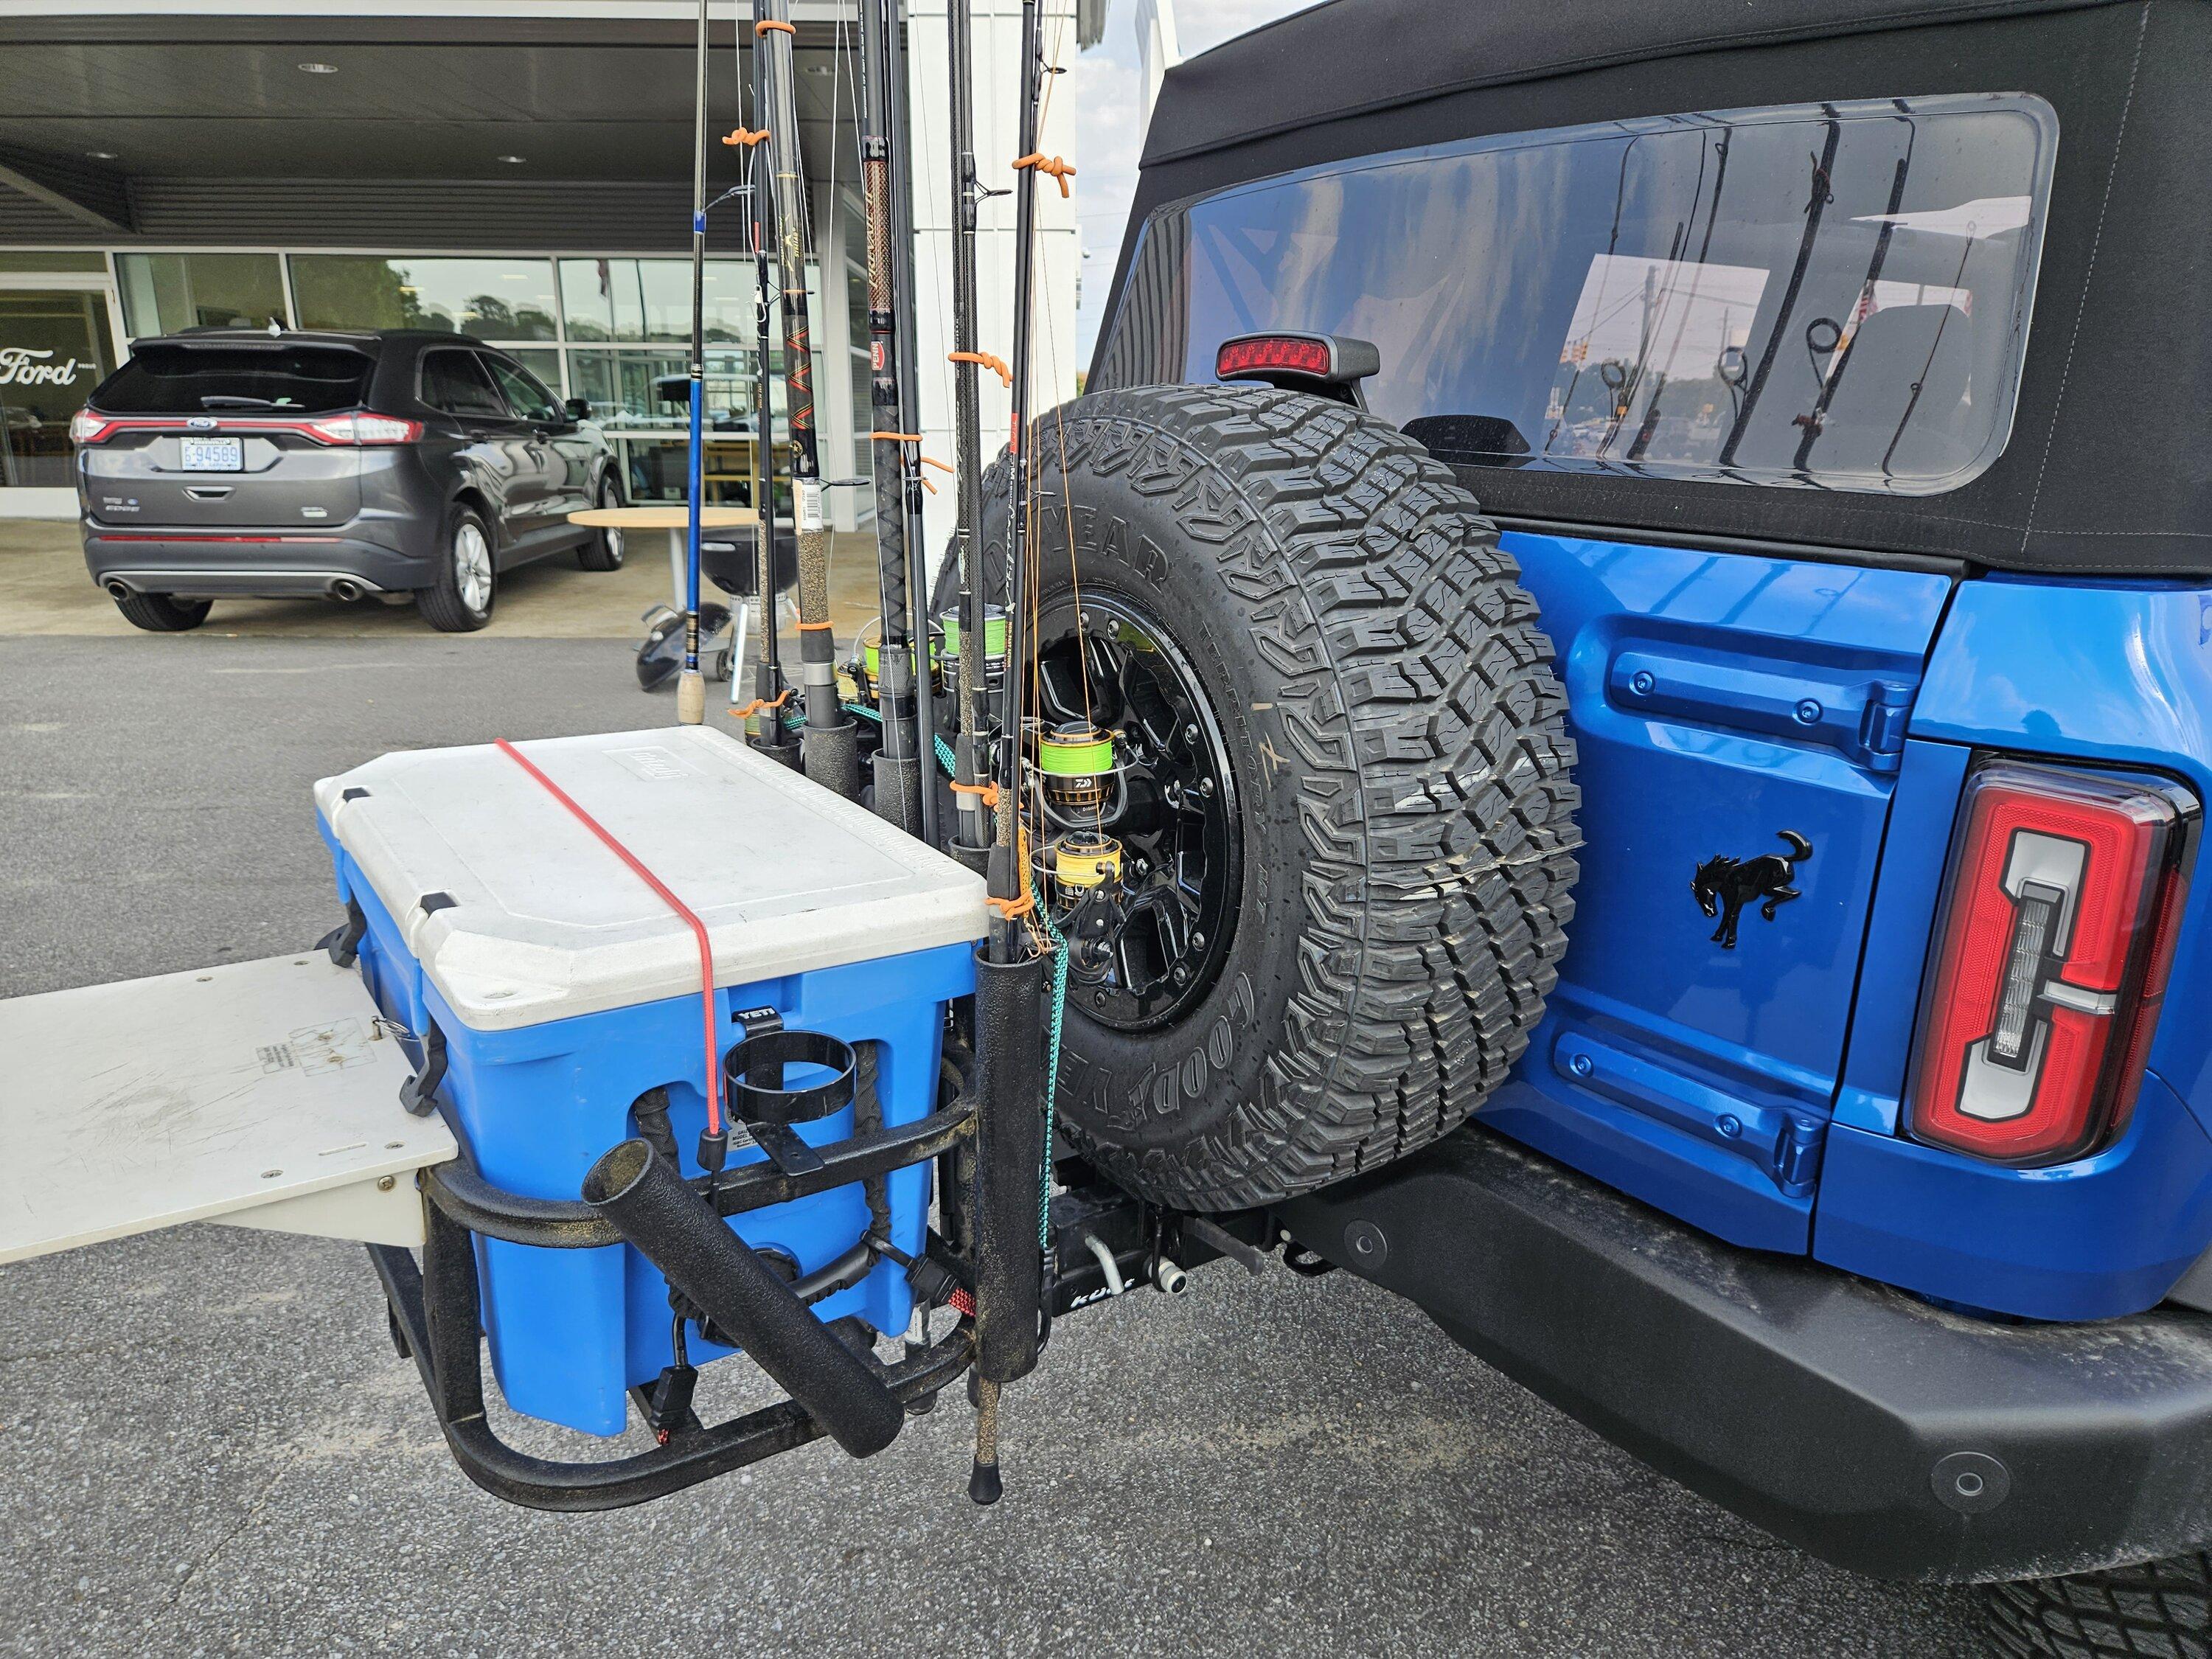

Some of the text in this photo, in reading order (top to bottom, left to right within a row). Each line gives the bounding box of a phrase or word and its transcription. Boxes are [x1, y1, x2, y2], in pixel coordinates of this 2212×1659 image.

[866, 212, 877, 288] PREVAIL
[0, 347, 77, 385] Ford
[872, 343, 880, 369] PENN
[1198, 620, 1267, 835] TERRITORY
[732, 1133, 748, 1141] MODEL
